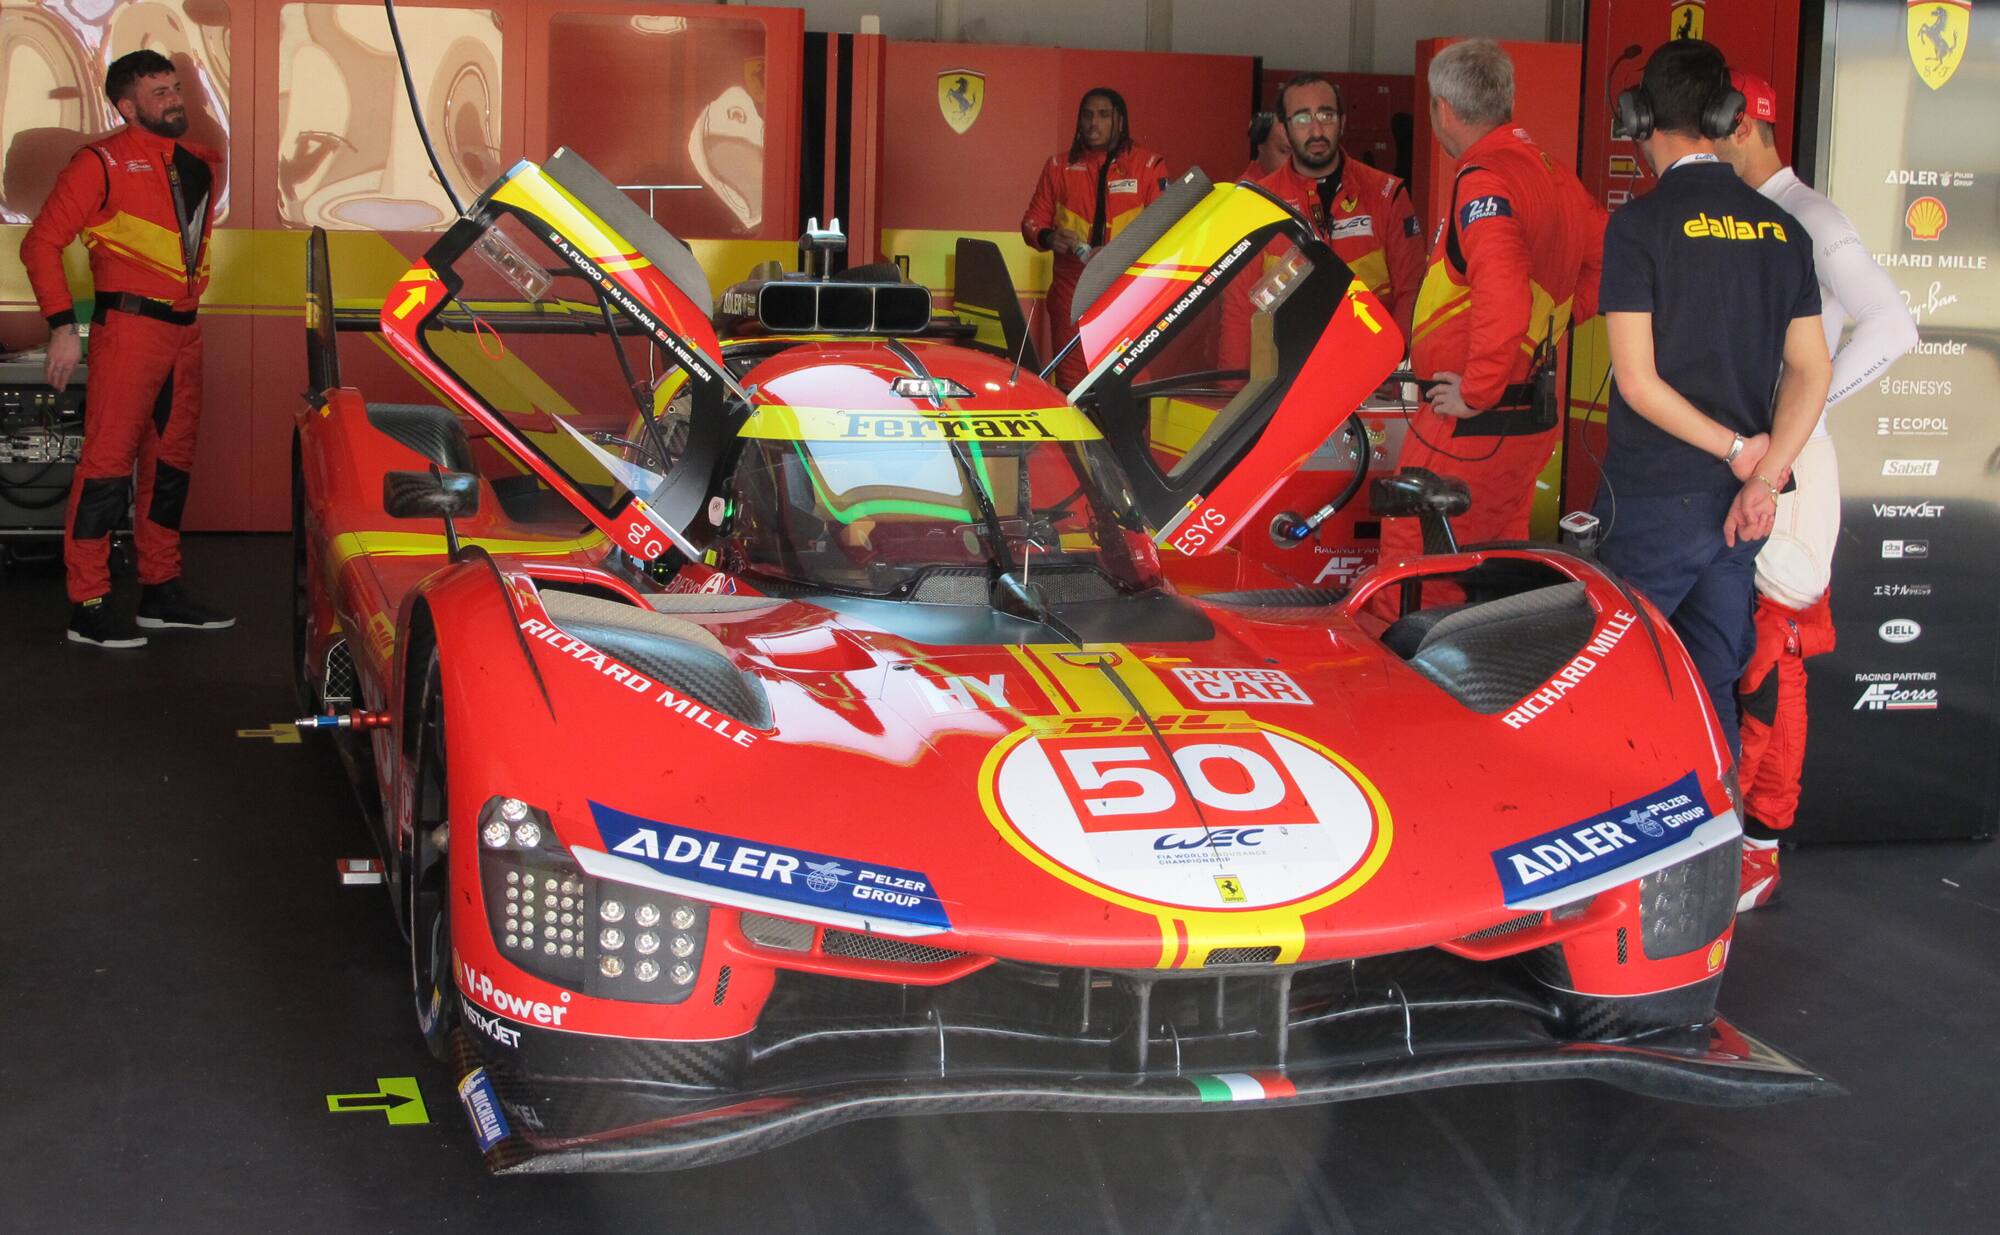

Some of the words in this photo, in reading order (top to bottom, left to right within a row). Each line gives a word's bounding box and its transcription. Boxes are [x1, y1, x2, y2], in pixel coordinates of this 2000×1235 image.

[1885, 170, 1938, 186] ADLER
[1684, 212, 1787, 242] dallara
[569, 249, 603, 281] FUOCO
[1218, 239, 1252, 271] NIELSEN
[1872, 253, 1933, 268] CHARD
[1938, 255, 1988, 270] MILLE
[1173, 284, 1207, 315] MOLINA
[1899, 281, 1958, 325] y-Ban
[621, 297, 656, 331] MOLINA
[1130, 329, 1160, 358] FUOCO
[1904, 339, 1967, 355] ntander
[674, 346, 712, 382] NIELSEN
[1892, 380, 1952, 396] GENESYS
[840, 411, 1055, 438] Ferrari
[1893, 417, 1949, 430] ECOPOL
[1888, 461, 1933, 474] Sabelt
[1872, 500, 1945, 517] VISTAJET
[1173, 508, 1226, 557] ESYS
[644, 540, 662, 559] G
[1885, 625, 1914, 635] BELL
[1180, 668, 1283, 683] HYPER
[1501, 655, 1597, 730] RICHARD
[1586, 608, 1637, 661] MILLE
[1854, 672, 1891, 682] RACING
[1892, 671, 1937, 681] PARTNER
[520, 617, 652, 694] RICHARD
[655, 690, 758, 749] MILLE
[1195, 681, 1302, 701] CAR
[1853, 683, 1899, 710] AF
[1061, 714, 1229, 733] DHL
[1059, 743, 1286, 817] 50
[1646, 794, 1692, 816] PELZER
[1662, 806, 1705, 828] GROUP
[1153, 828, 1264, 850] WEC
[612, 827, 799, 884] ADLER
[1158, 857, 1231, 865] CHAMPIONSHIP
[1507, 821, 1637, 886] ADLER
[857, 869, 926, 892] PELZER
[851, 884, 921, 908] GROUP
[464, 963, 568, 1026] V-Power
[471, 1088, 502, 1142] MICHELIN
